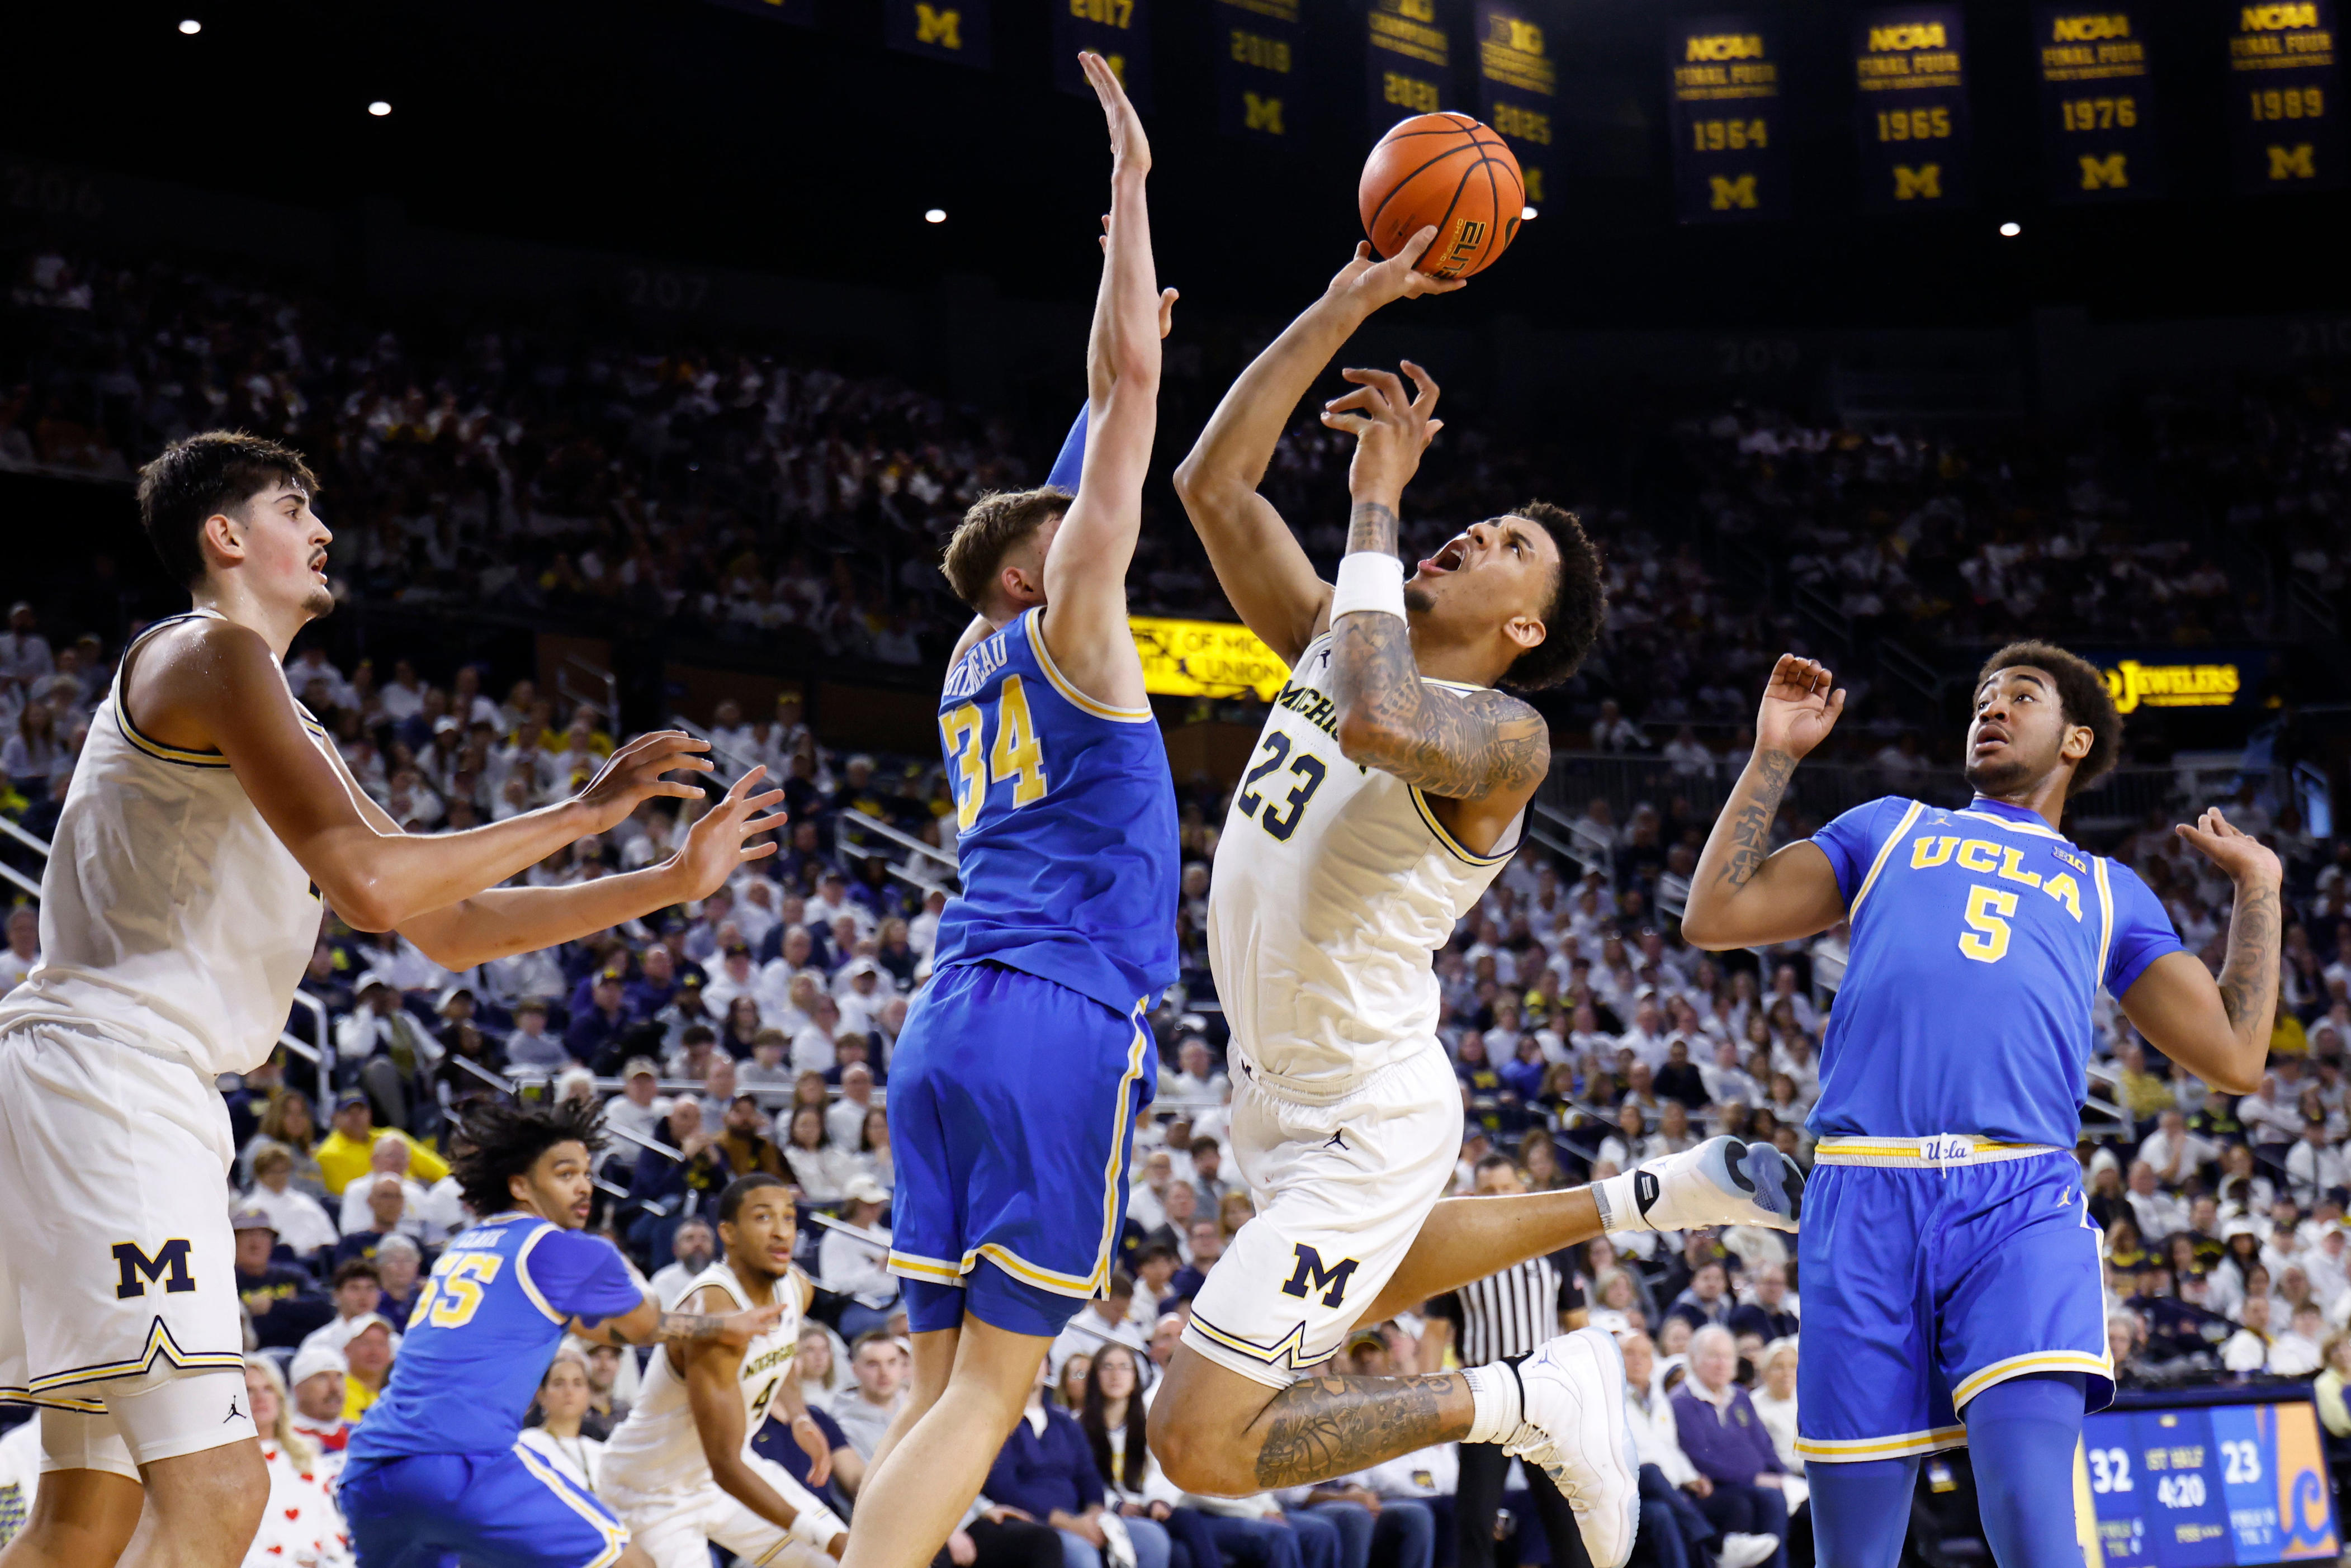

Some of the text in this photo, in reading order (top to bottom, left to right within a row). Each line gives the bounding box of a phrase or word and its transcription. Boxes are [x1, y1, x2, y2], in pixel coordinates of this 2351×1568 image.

[915, 3, 962, 50] M
[2053, 14, 2129, 42] NCAA
[2240, 2, 2318, 32] NCAA
[1685, 33, 1764, 61] NCAA
[1869, 23, 1946, 51] NCAA
[2097, 43, 2144, 63] FOUR
[2283, 32, 2332, 53] FOUR
[1730, 63, 1777, 83] FOUR
[1913, 53, 1961, 73] FOUR
[1242, 91, 1285, 135] M
[2062, 96, 2137, 131] 1976
[2250, 87, 2324, 121] 1989
[1693, 118, 1768, 151] 1964
[1877, 107, 1951, 141] 1965
[2079, 153, 2128, 190] M
[2266, 144, 2315, 180] M
[1710, 174, 1758, 210] M
[1893, 164, 1942, 200] M
[938, 674, 1047, 833] 34
[1237, 729, 1328, 844] 23
[1910, 836, 2083, 923] UCLA
[1958, 884, 2019, 964] 5
[110, 1237, 197, 1300] M
[1280, 1242, 1361, 1309] M
[407, 1250, 505, 1329] 55
[753, 1376, 779, 1420] 4
[2088, 1447, 2134, 1494] 32
[2221, 1439, 2262, 1484] 23
[2157, 1472, 2207, 1509] 4:20
